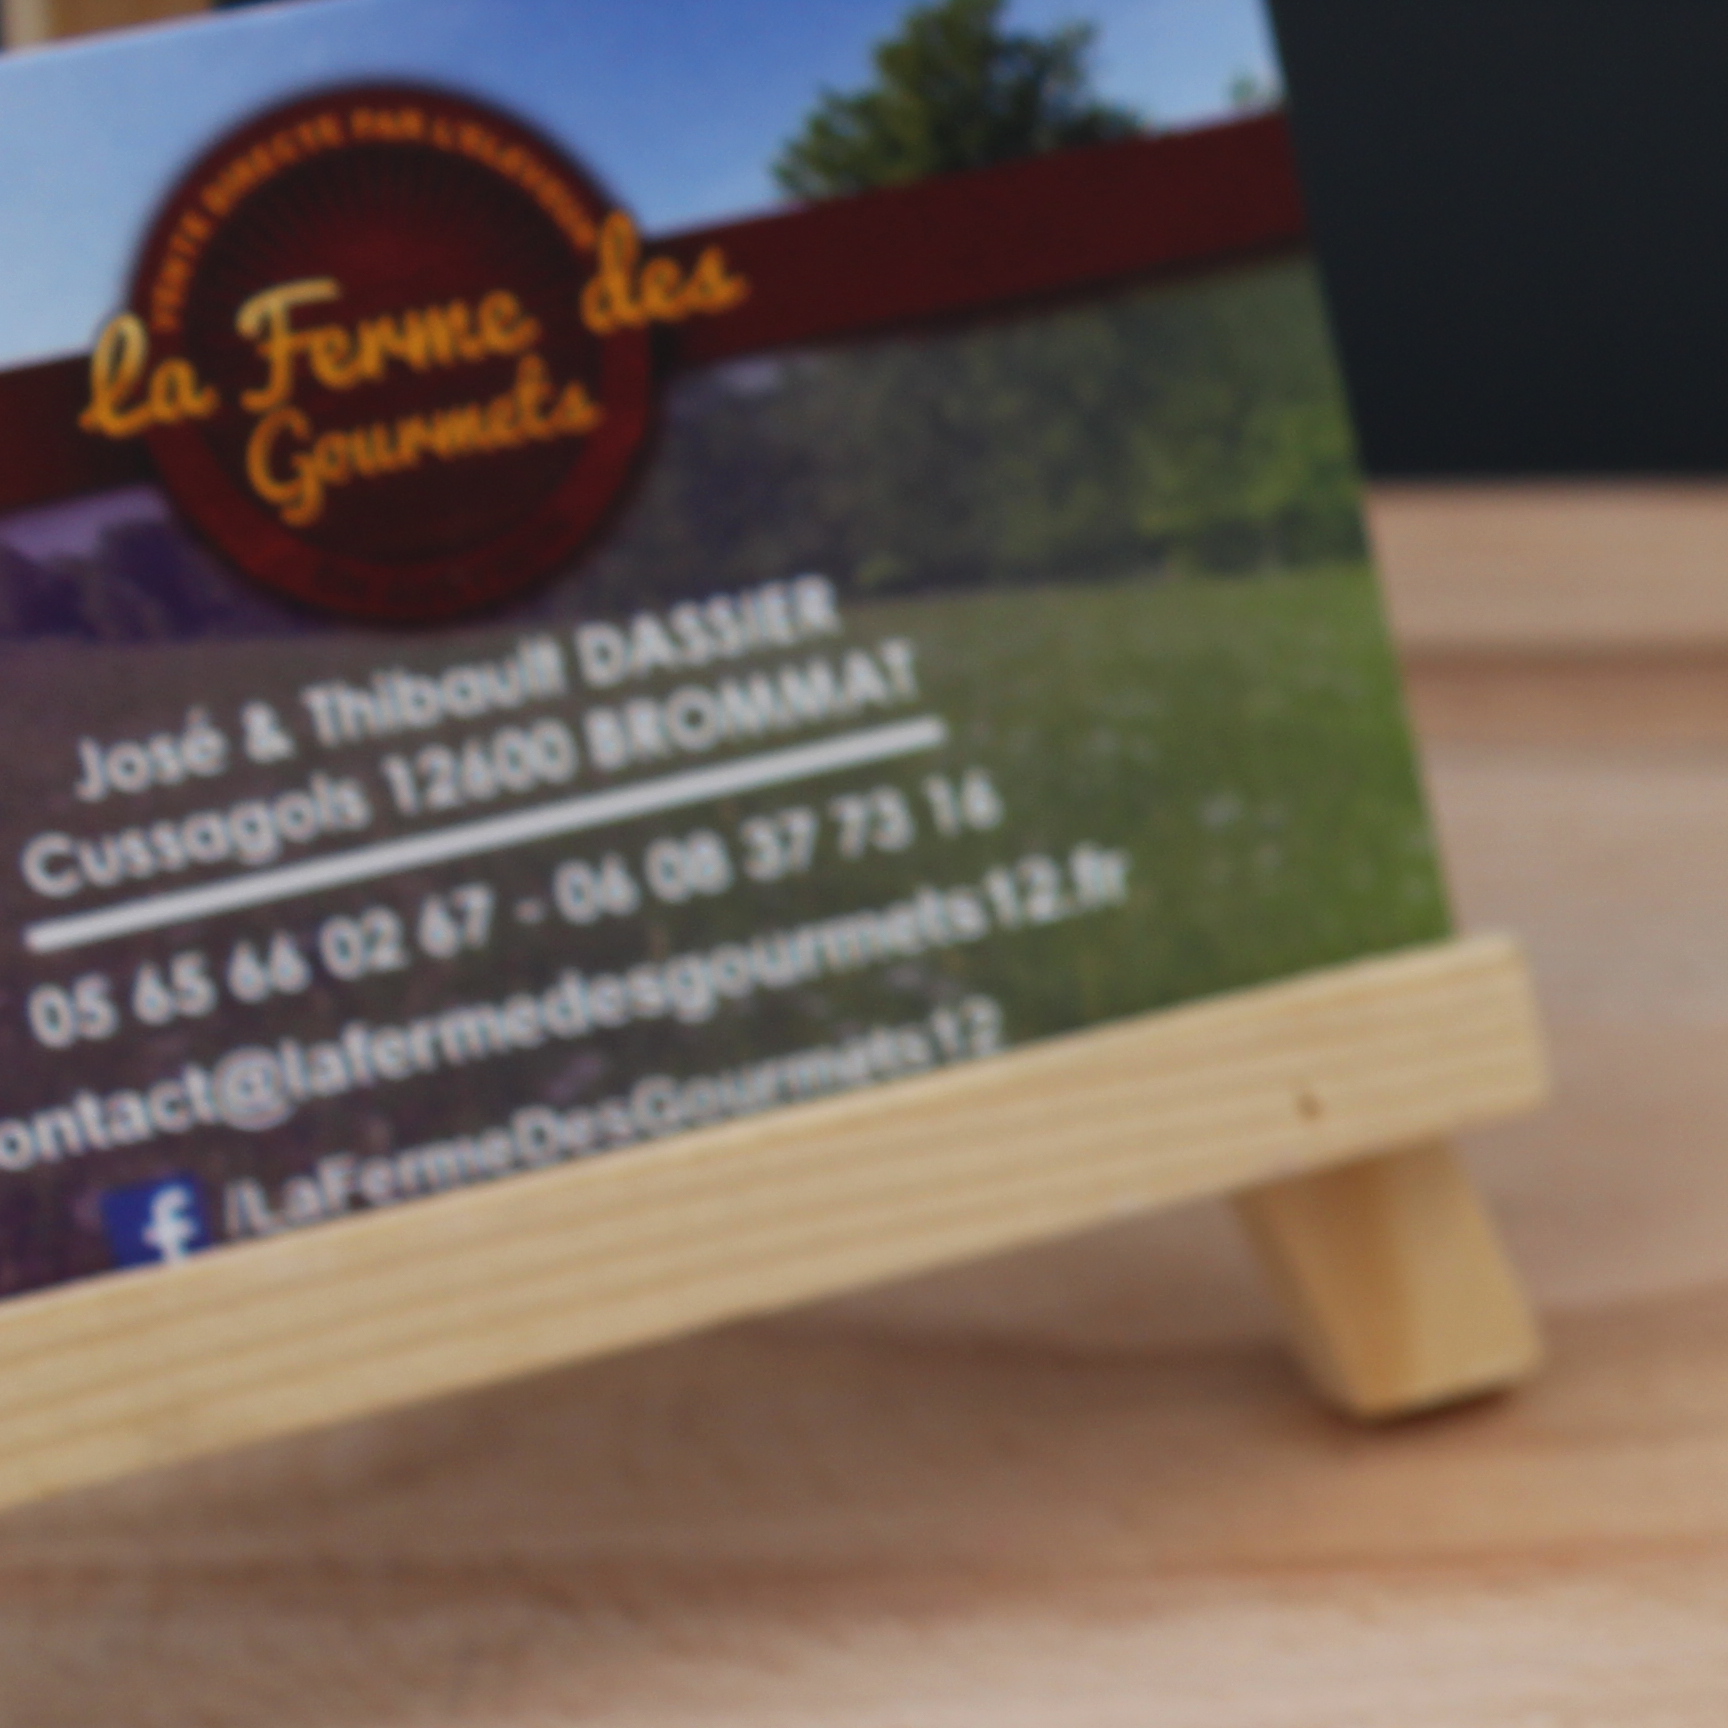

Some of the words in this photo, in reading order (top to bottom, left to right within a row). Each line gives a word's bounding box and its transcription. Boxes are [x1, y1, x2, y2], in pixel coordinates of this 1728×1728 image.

[237, 277, 540, 412] Ferme
[579, 211, 751, 335] des
[247, 354, 599, 526] Gourmets
[20, 772, 372, 896] Cussagols
[383, 718, 577, 816] 12600
[582, 638, 916, 770] BROMMAT
[75, 705, 228, 800] José
[241, 701, 293, 763] &
[304, 635, 566, 747] Thibault
[573, 574, 840, 687] DASSIER
[28, 972, 118, 1049] 05
[131, 950, 217, 1025] 65
[227, 930, 311, 1003] 66
[319, 905, 407, 981] 02
[418, 882, 494, 958] 67
[552, 849, 638, 925] 06
[644, 827, 735, 901] 08
[740, 805, 819, 882] 37
[828, 784, 915, 859] 73
[922, 764, 1005, 837] 16
